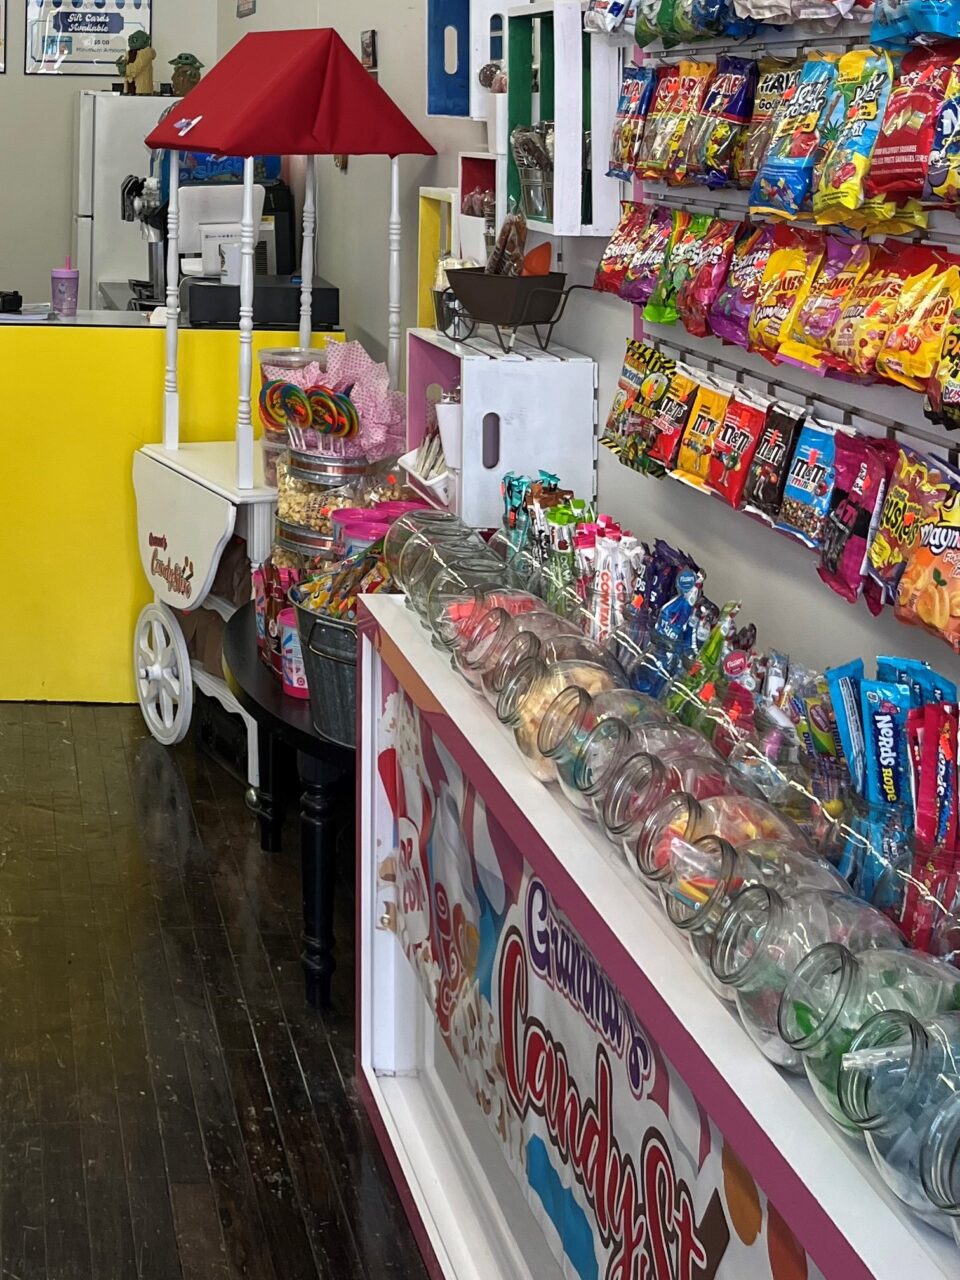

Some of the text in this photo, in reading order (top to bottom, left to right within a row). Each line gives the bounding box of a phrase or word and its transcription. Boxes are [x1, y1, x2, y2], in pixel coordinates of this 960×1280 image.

[67, 13, 110, 23] Gift Cards
[68, 22, 109, 32] Available
[499, 925, 646, 1280] Candy
